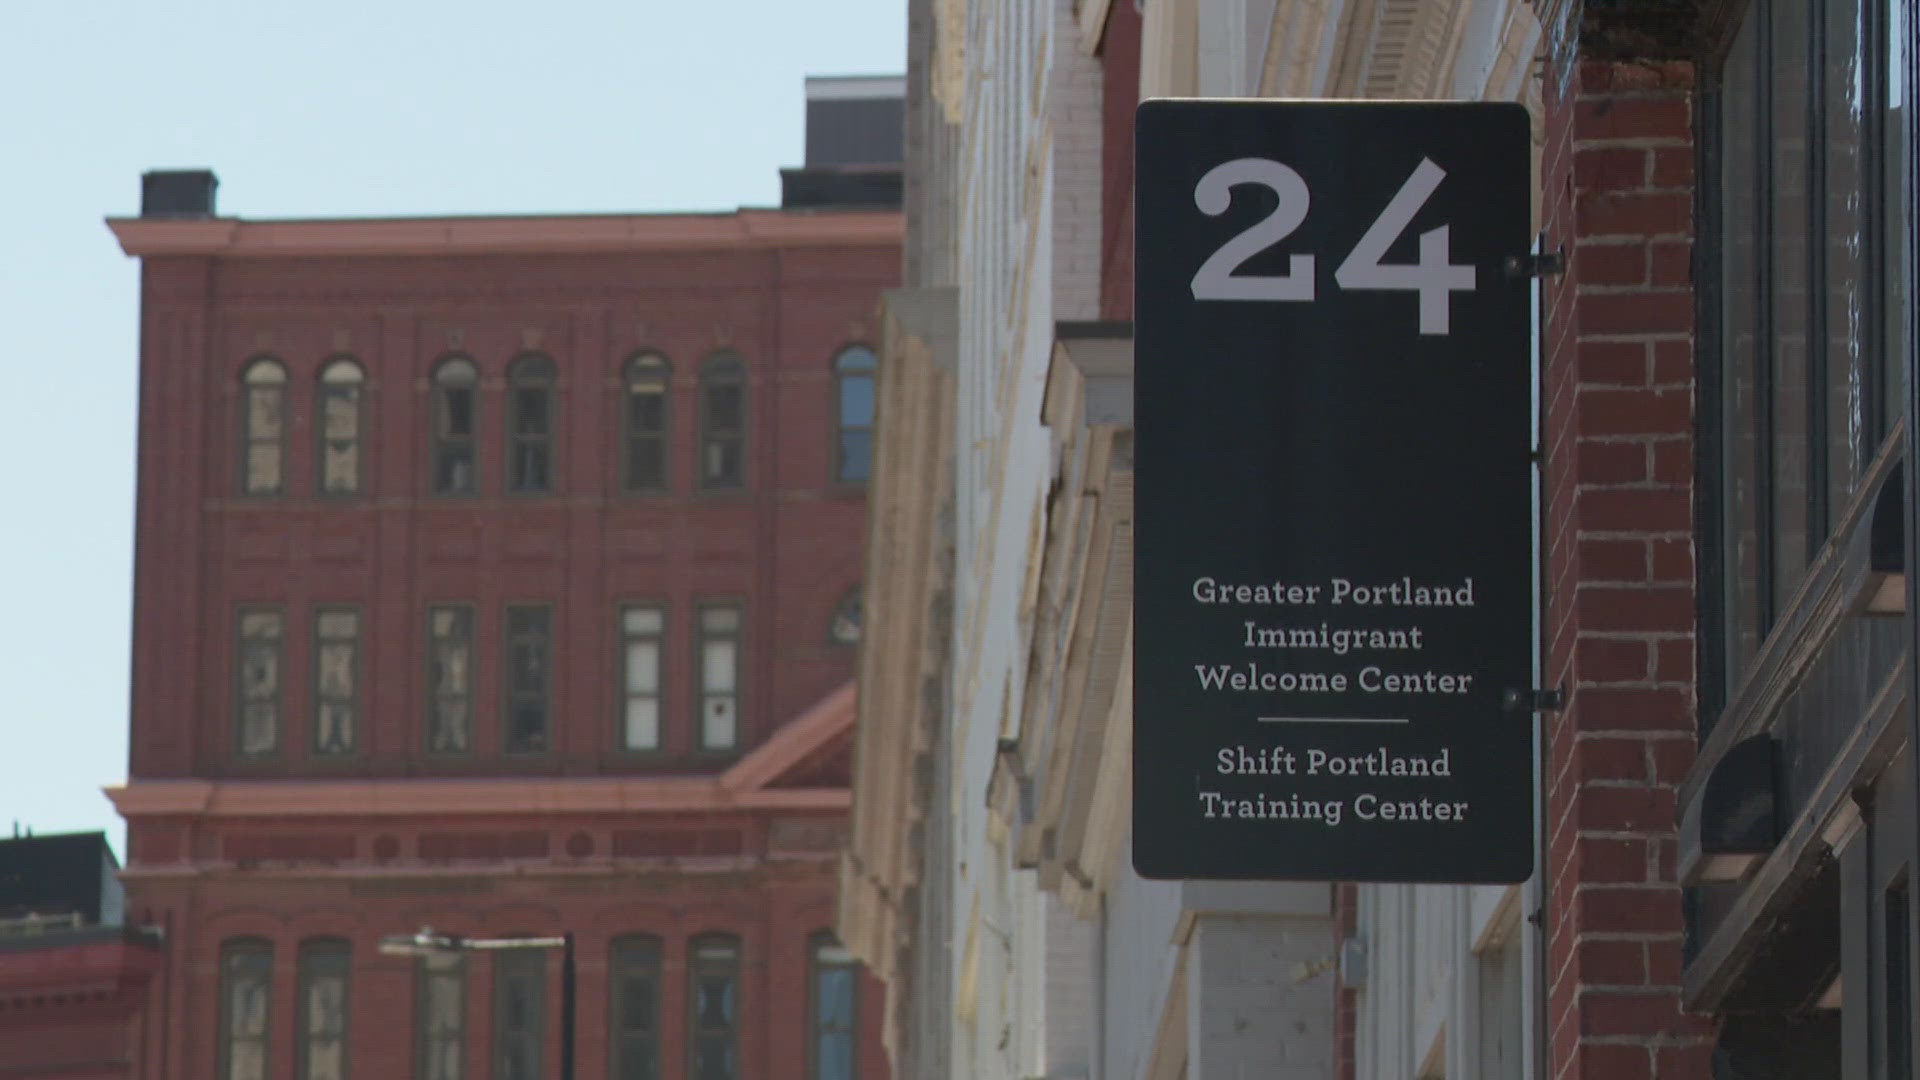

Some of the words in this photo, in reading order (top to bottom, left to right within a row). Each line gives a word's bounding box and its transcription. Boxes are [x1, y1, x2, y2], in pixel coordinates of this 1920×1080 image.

[1190, 156, 1476, 335] 24
[1192, 576, 1321, 605] Greater
[1331, 577, 1475, 606] Portland
[1244, 621, 1423, 655] Immigrant
[1194, 662, 1348, 692] Welcome
[1358, 666, 1473, 694] Center
[1216, 745, 1297, 776] Shift
[1307, 747, 1451, 777] Portland
[1199, 792, 1343, 826] Training
[1354, 793, 1469, 821] Center
